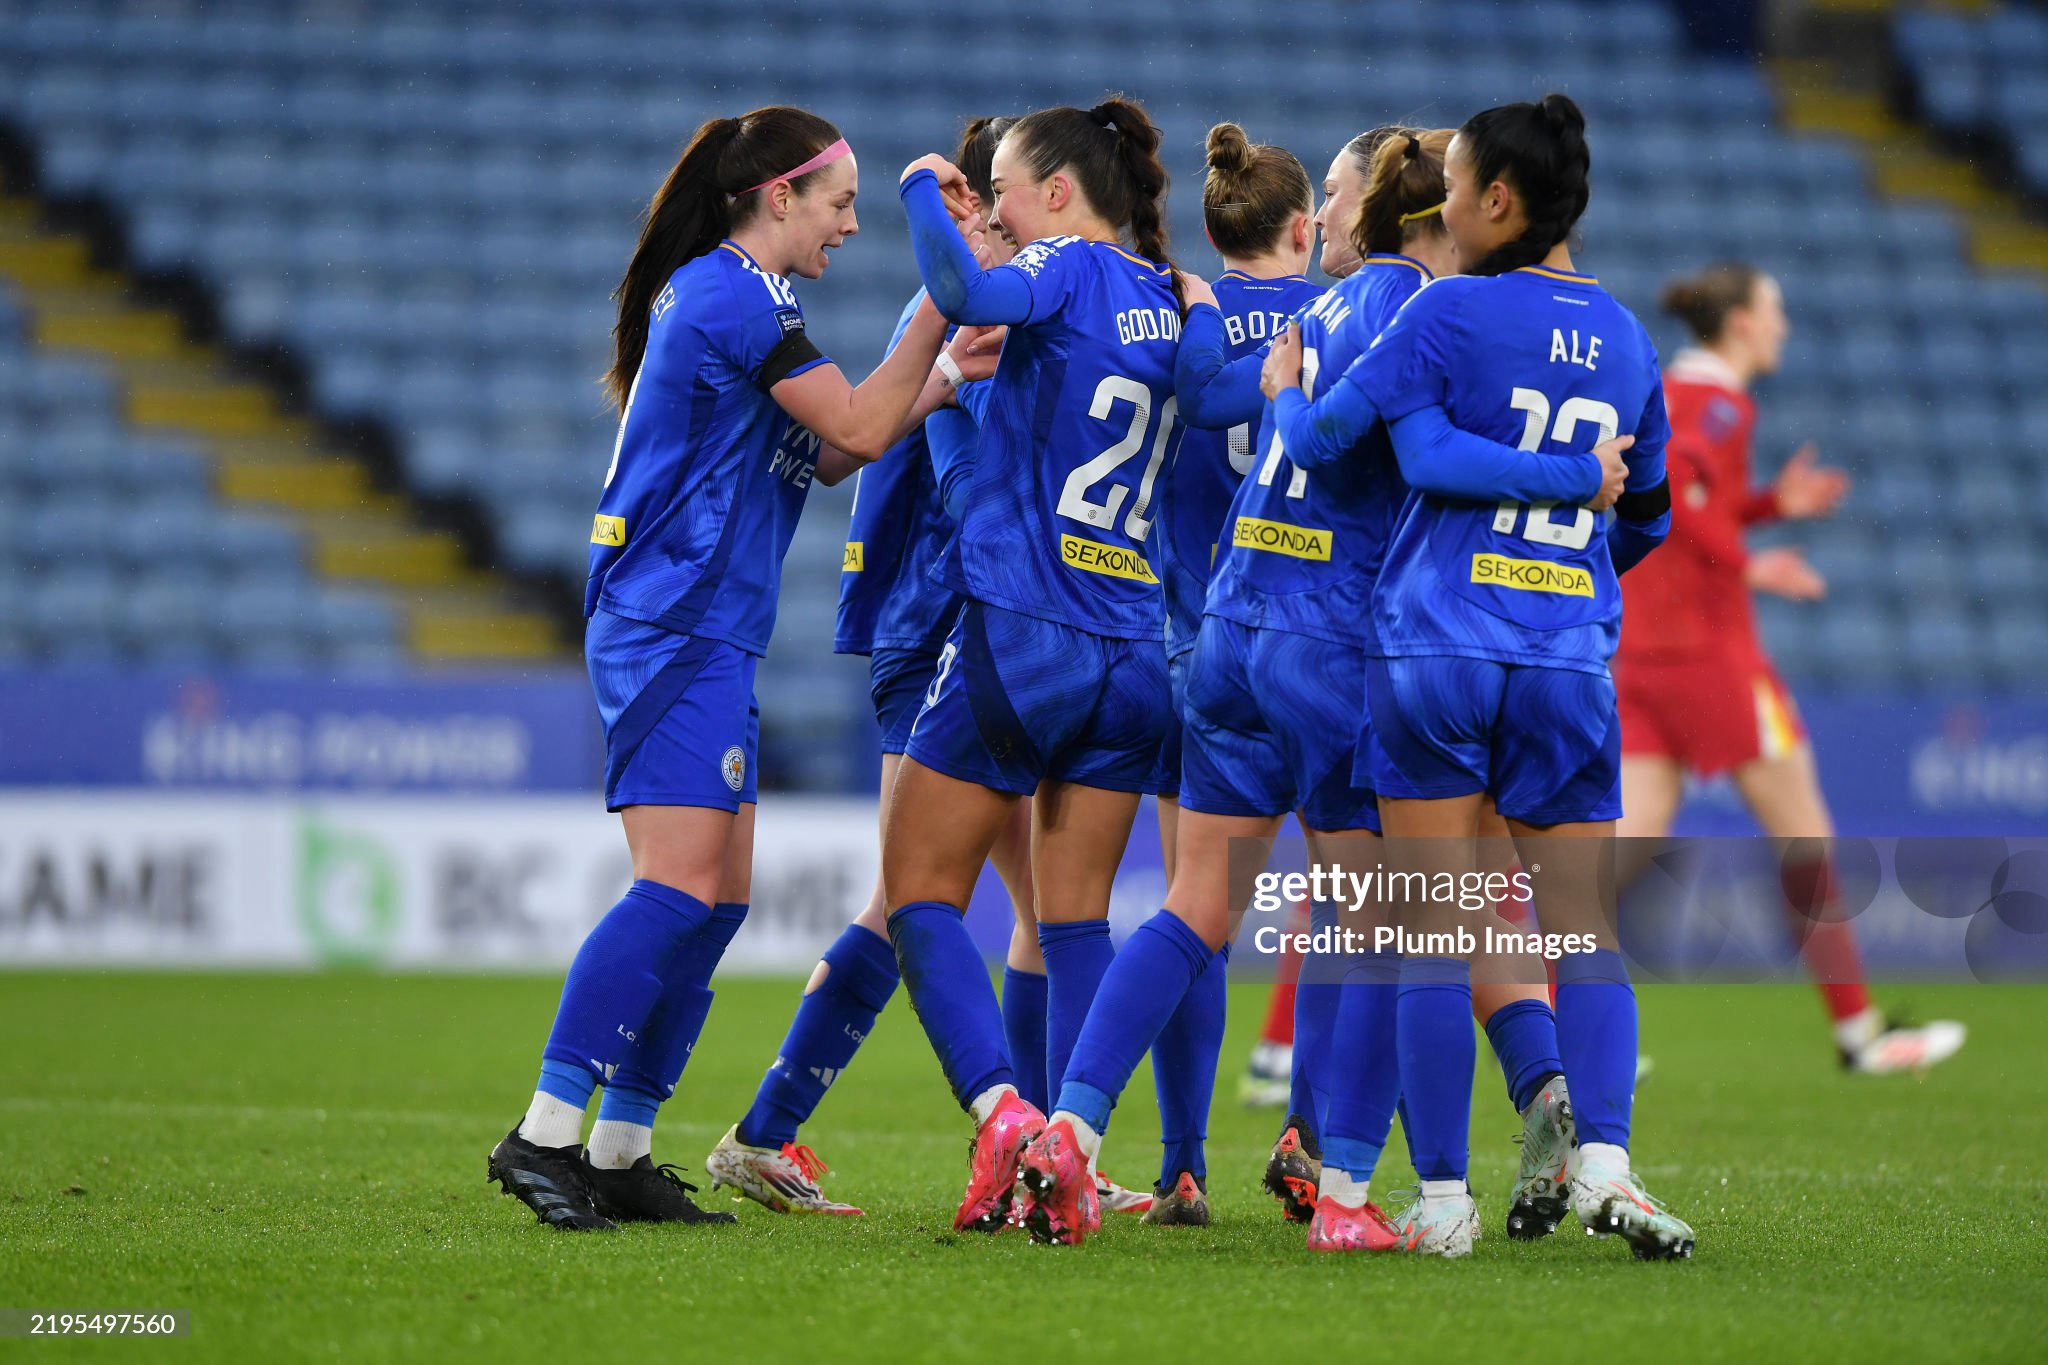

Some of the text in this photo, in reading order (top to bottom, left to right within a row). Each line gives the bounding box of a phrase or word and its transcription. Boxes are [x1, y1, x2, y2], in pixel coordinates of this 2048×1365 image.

[1225, 310, 1295, 347] BOT
[1549, 328, 1602, 371] ALE
[1233, 522, 1323, 555] SEKONDA
[1064, 540, 1153, 579] SEKONDA
[1475, 558, 1591, 592] SEKONDA
